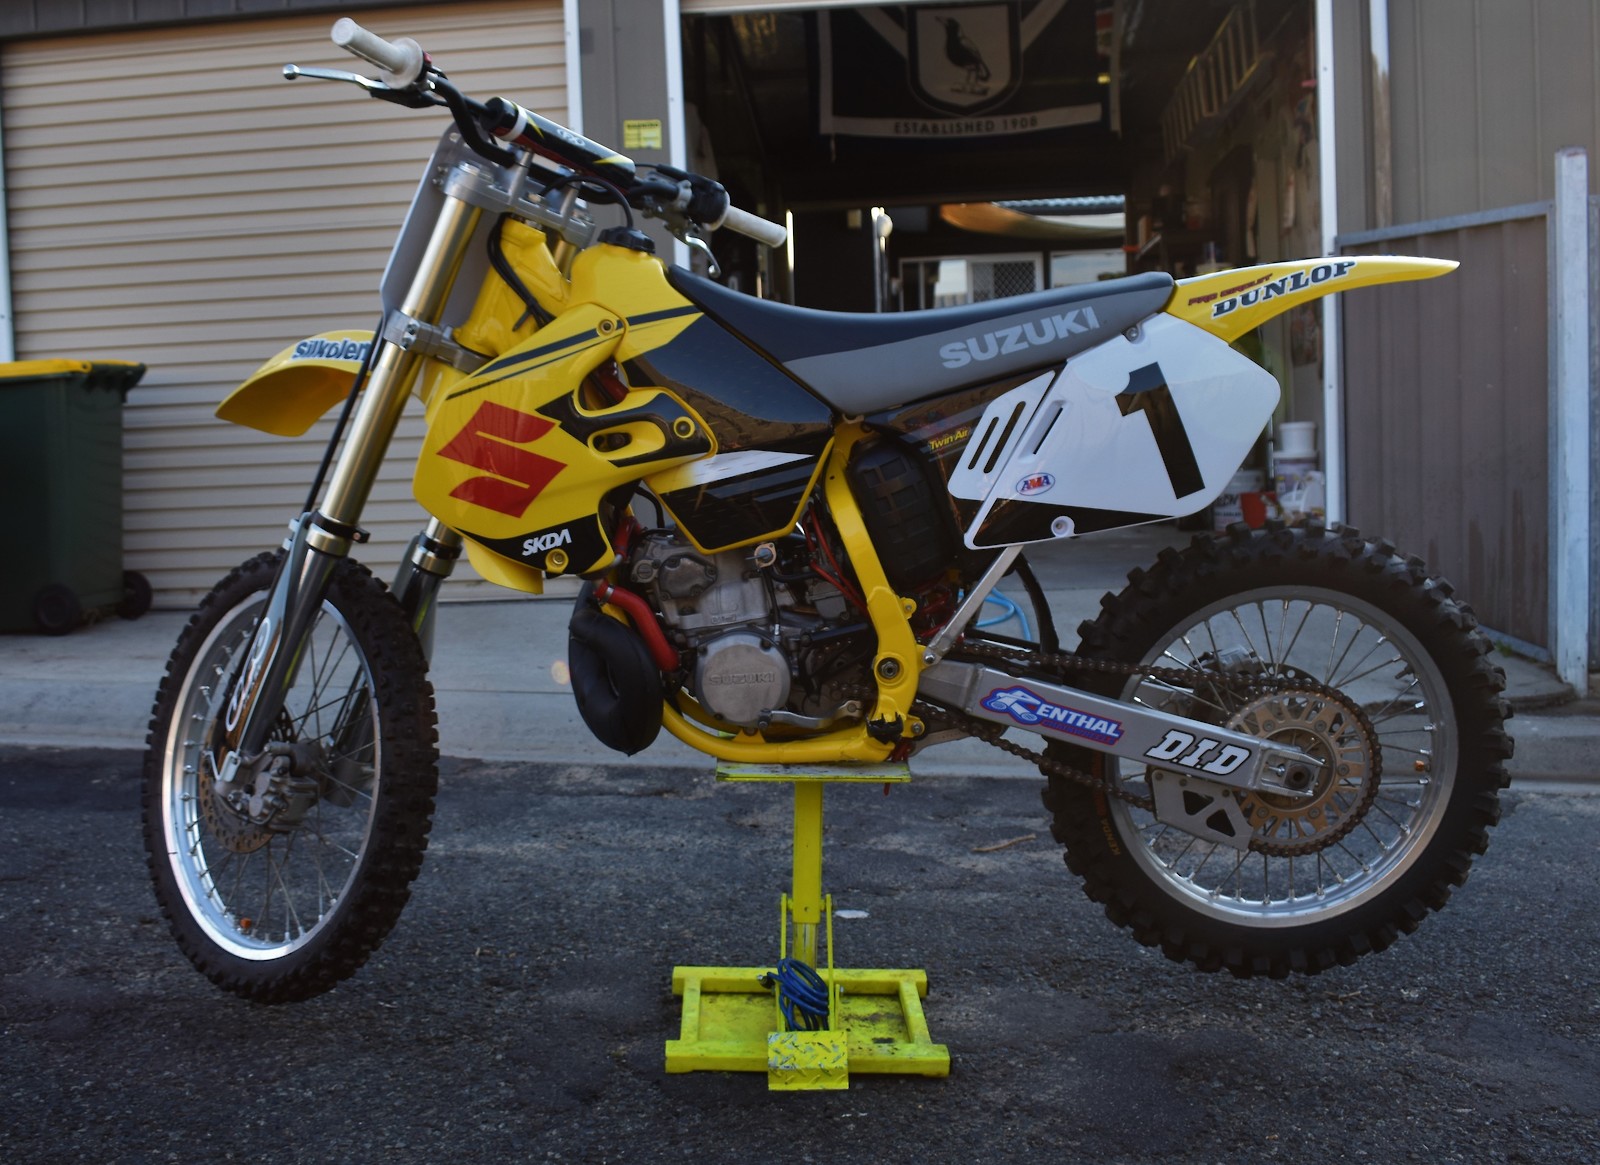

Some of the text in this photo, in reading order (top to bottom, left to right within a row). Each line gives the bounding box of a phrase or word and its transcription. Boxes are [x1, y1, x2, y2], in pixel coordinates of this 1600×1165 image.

[894, 115, 1038, 134] ESTABLISHED 1908
[1212, 260, 1356, 318] DUNLOP
[938, 305, 1100, 369] SUZUKI
[929, 427, 969, 451] Twin Air
[1115, 361, 1206, 500] 1
[1020, 474, 1051, 491] AMA
[521, 528, 573, 557] SKDA
[709, 671, 776, 686] SUZUKI
[1099, 818, 1121, 856] KENDA
